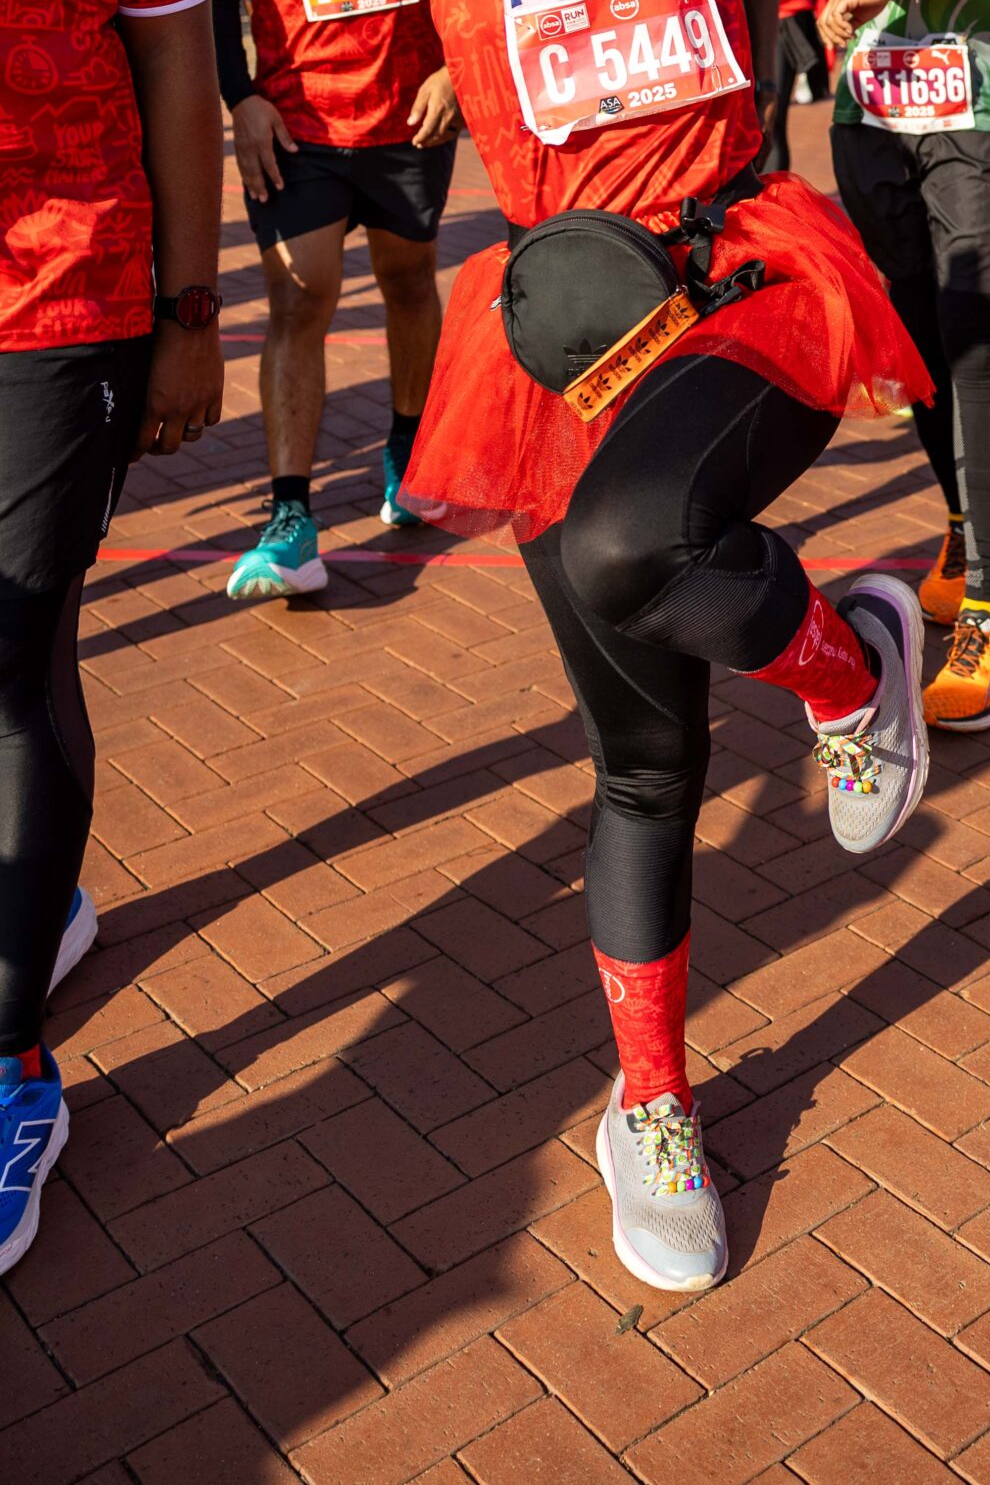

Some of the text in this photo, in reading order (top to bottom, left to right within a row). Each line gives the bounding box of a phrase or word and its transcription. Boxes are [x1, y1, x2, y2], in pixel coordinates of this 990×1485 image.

[613, 1, 636, 12] absa
[563, 9, 585, 22] RUN
[543, 20, 560, 30] absa
[539, 10, 716, 104] C 5449
[858, 67, 966, 106] F11636
[628, 83, 678, 108] 2025
[600, 97, 621, 110] ASA
[904, 105, 935, 117] 2025
